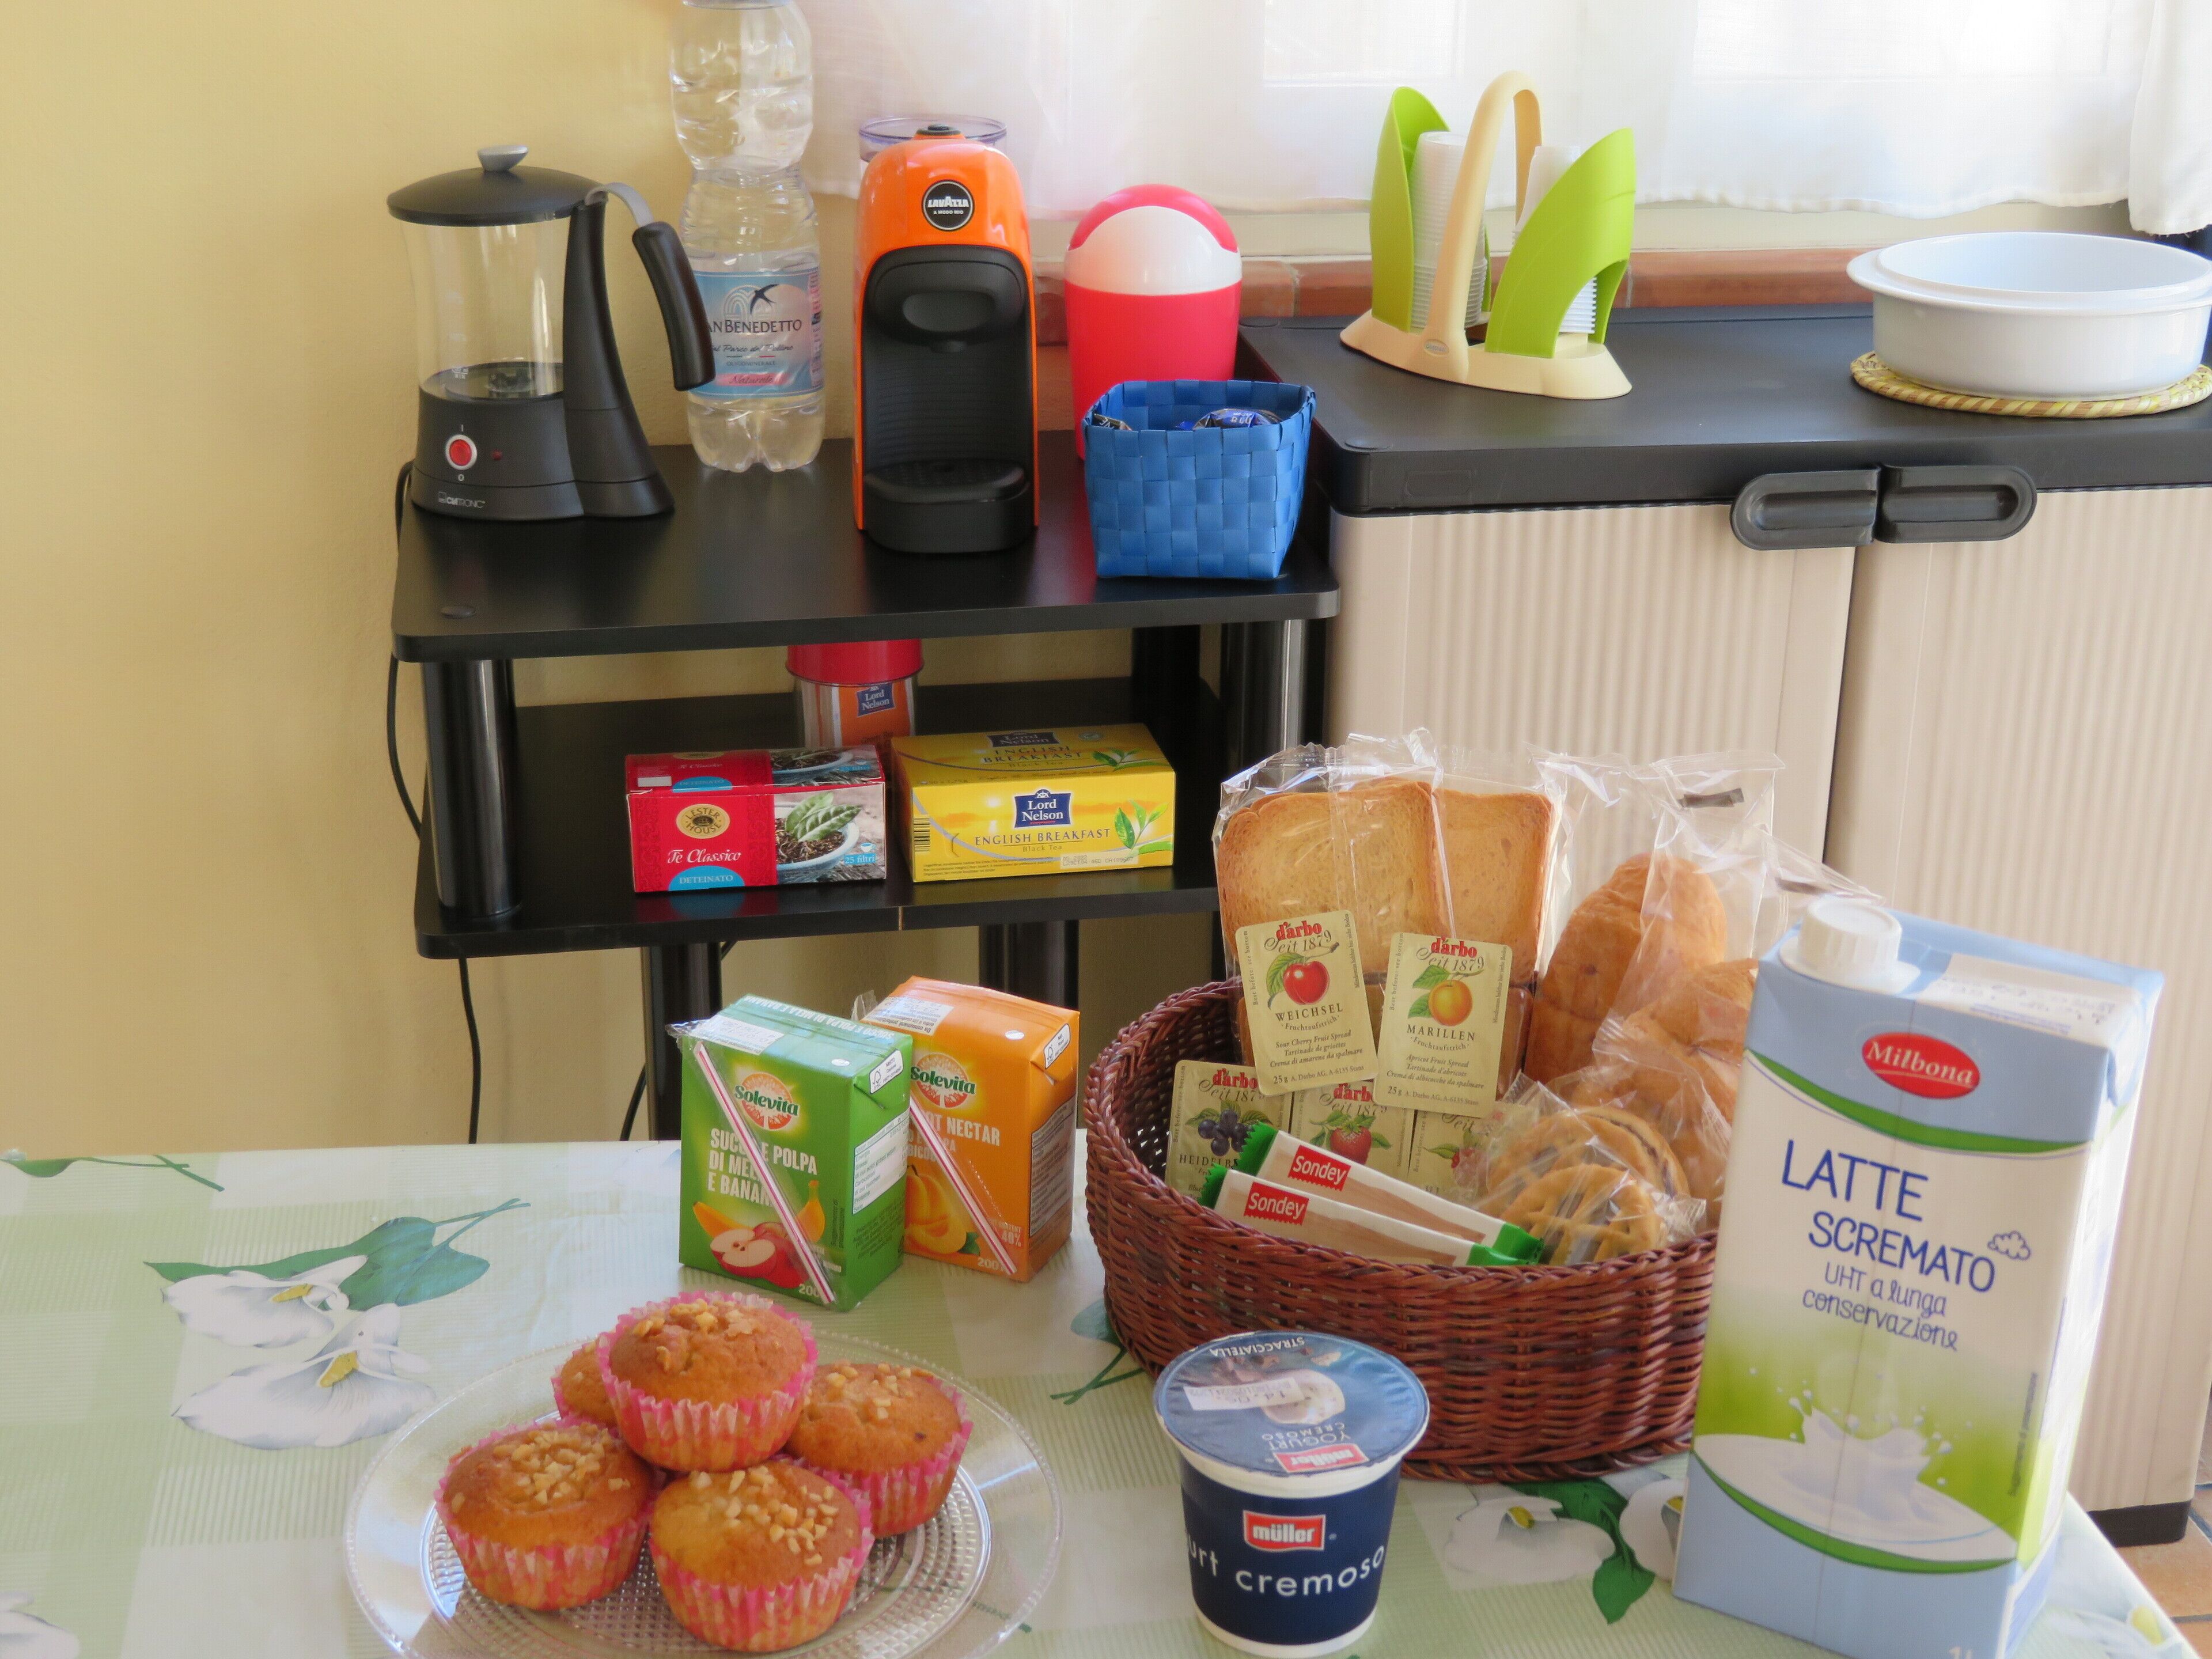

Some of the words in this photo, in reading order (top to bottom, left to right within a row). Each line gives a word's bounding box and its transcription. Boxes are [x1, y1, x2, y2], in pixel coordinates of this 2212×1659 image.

[927, 196, 969, 207] LAVAZZA
[709, 322, 722, 333] AN
[725, 319, 802, 333] BENEDETTO
[862, 698, 889, 711] Nelson
[865, 690, 884, 701] Lord
[983, 752, 1082, 763] BREAKFAST
[995, 746, 1070, 755] ENGLISH
[1028, 799, 1056, 810] Lord
[685, 808, 719, 820] LESTER
[1022, 811, 1064, 821] Nelson
[686, 823, 722, 834] HOUSE
[975, 833, 1031, 846] ENGLISH
[1038, 828, 1111, 842] BREAKFAST
[687, 849, 742, 863] Classico
[680, 875, 733, 884] DETEINATO
[1264, 937, 1297, 953] Seit
[1302, 930, 1332, 952] 1879
[1416, 947, 1449, 967] Seit
[1453, 956, 1484, 971] 1879
[1274, 1002, 1343, 1022] WEICHSEL
[1285, 1016, 1338, 1031] Fruchtaufstrich
[1406, 1024, 1476, 1041] MARILLEN
[1331, 1029, 1351, 1039] Spread
[1284, 1047, 1314, 1056] Tartinade
[1323, 1041, 1346, 1052] griottes
[1413, 1036, 1467, 1051] Fruchtaufstrich
[1299, 1055, 1325, 1063] amarene
[1335, 1048, 1363, 1058] spalmare
[1406, 1054, 1429, 1063] Apricot
[1430, 1056, 1446, 1066] Fruit
[1448, 1059, 1469, 1068] Spread
[1866, 1040, 1973, 1085] Milbona
[1407, 1063, 1437, 1073] Tartinade
[911, 1066, 976, 1094] Solevita
[1273, 1075, 1283, 1085] 25
[1298, 1072, 1316, 1081] Darbo
[1387, 1070, 1407, 1079] Crema
[1408, 1073, 1415, 1081] di
[1456, 1080, 1484, 1089] spalmare
[1199, 1079, 1232, 1103] Seit
[1235, 1090, 1264, 1103] 187
[1387, 1086, 1397, 1094] 25
[734, 1085, 799, 1116] Solevita
[947, 1116, 1000, 1146] NECTAR
[709, 1150, 725, 1172] DI
[729, 1154, 760, 1181] MEL
[773, 1145, 817, 1175] POLPA
[1293, 1156, 1347, 1184] Sondey
[707, 1172, 717, 1191] E
[1782, 1139, 1929, 1221] LATTE
[1248, 1192, 1305, 1219] Sondey
[1808, 1211, 1995, 1293] SCREMATO
[1824, 1262, 1866, 1292] UHT
[1870, 1278, 1884, 1299] a
[1890, 1280, 1947, 1318] lunga
[1802, 1289, 1957, 1352] conservazione
[1210, 1336, 1305, 1358] STRACCIATELLA
[1262, 1422, 1346, 1441] CREMOSO
[1268, 1430, 1351, 1450] YOGURT
[1290, 1449, 1354, 1466] müller
[1252, 1523, 1316, 1544] müller
[1235, 1545, 1384, 1597] cremoso
